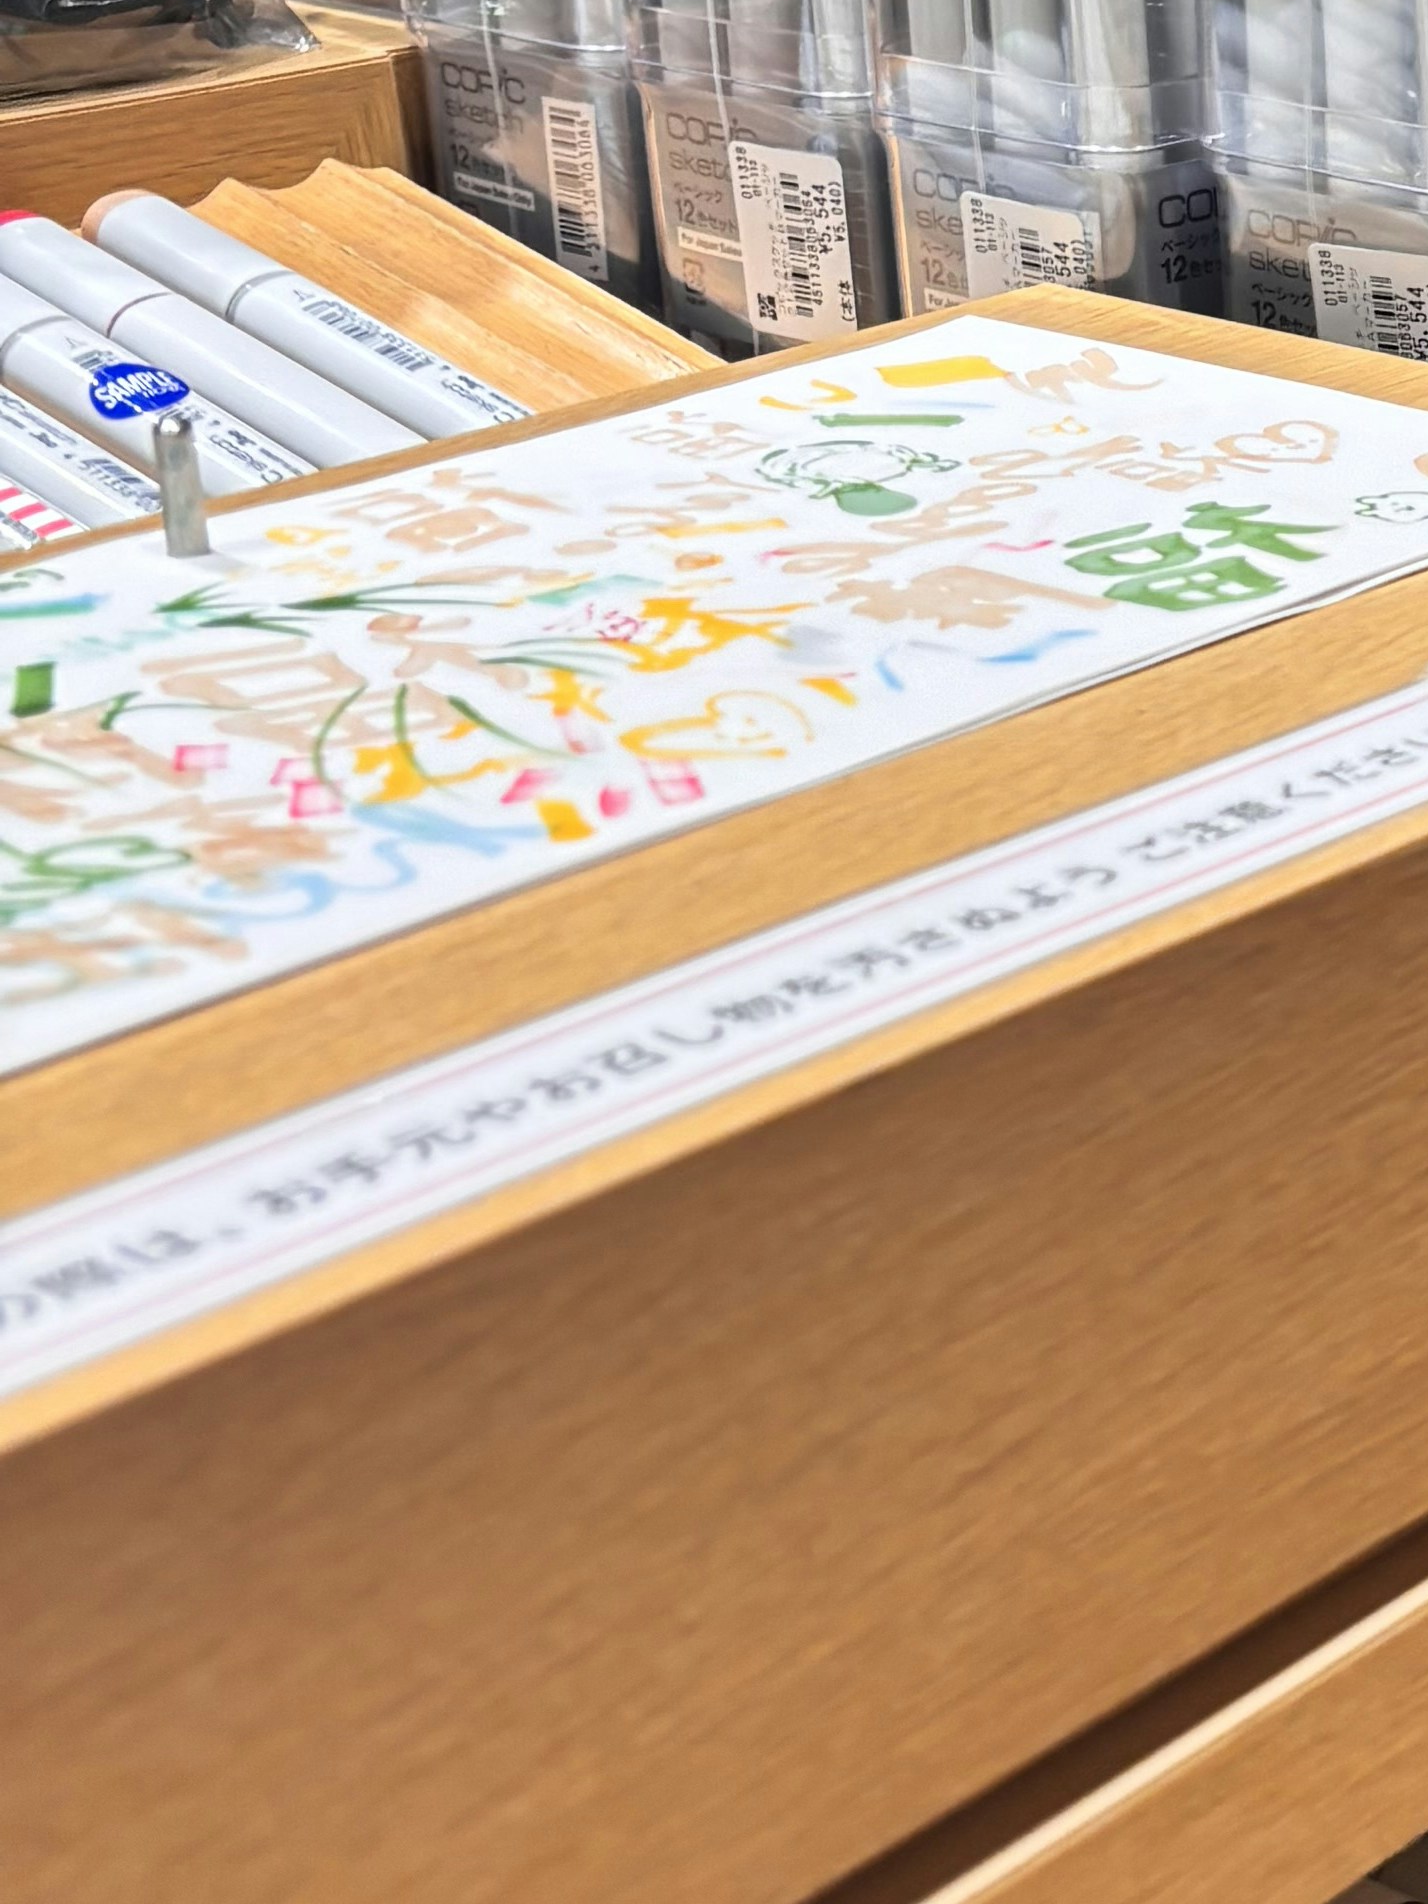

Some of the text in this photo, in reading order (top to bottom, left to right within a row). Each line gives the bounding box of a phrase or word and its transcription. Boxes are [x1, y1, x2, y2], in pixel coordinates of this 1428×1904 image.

[736, 146, 753, 199] 011338
[970, 197, 987, 254] 011338
[1318, 250, 1338, 306] 011338
[1409, 287, 1427, 360] ¥5,544
